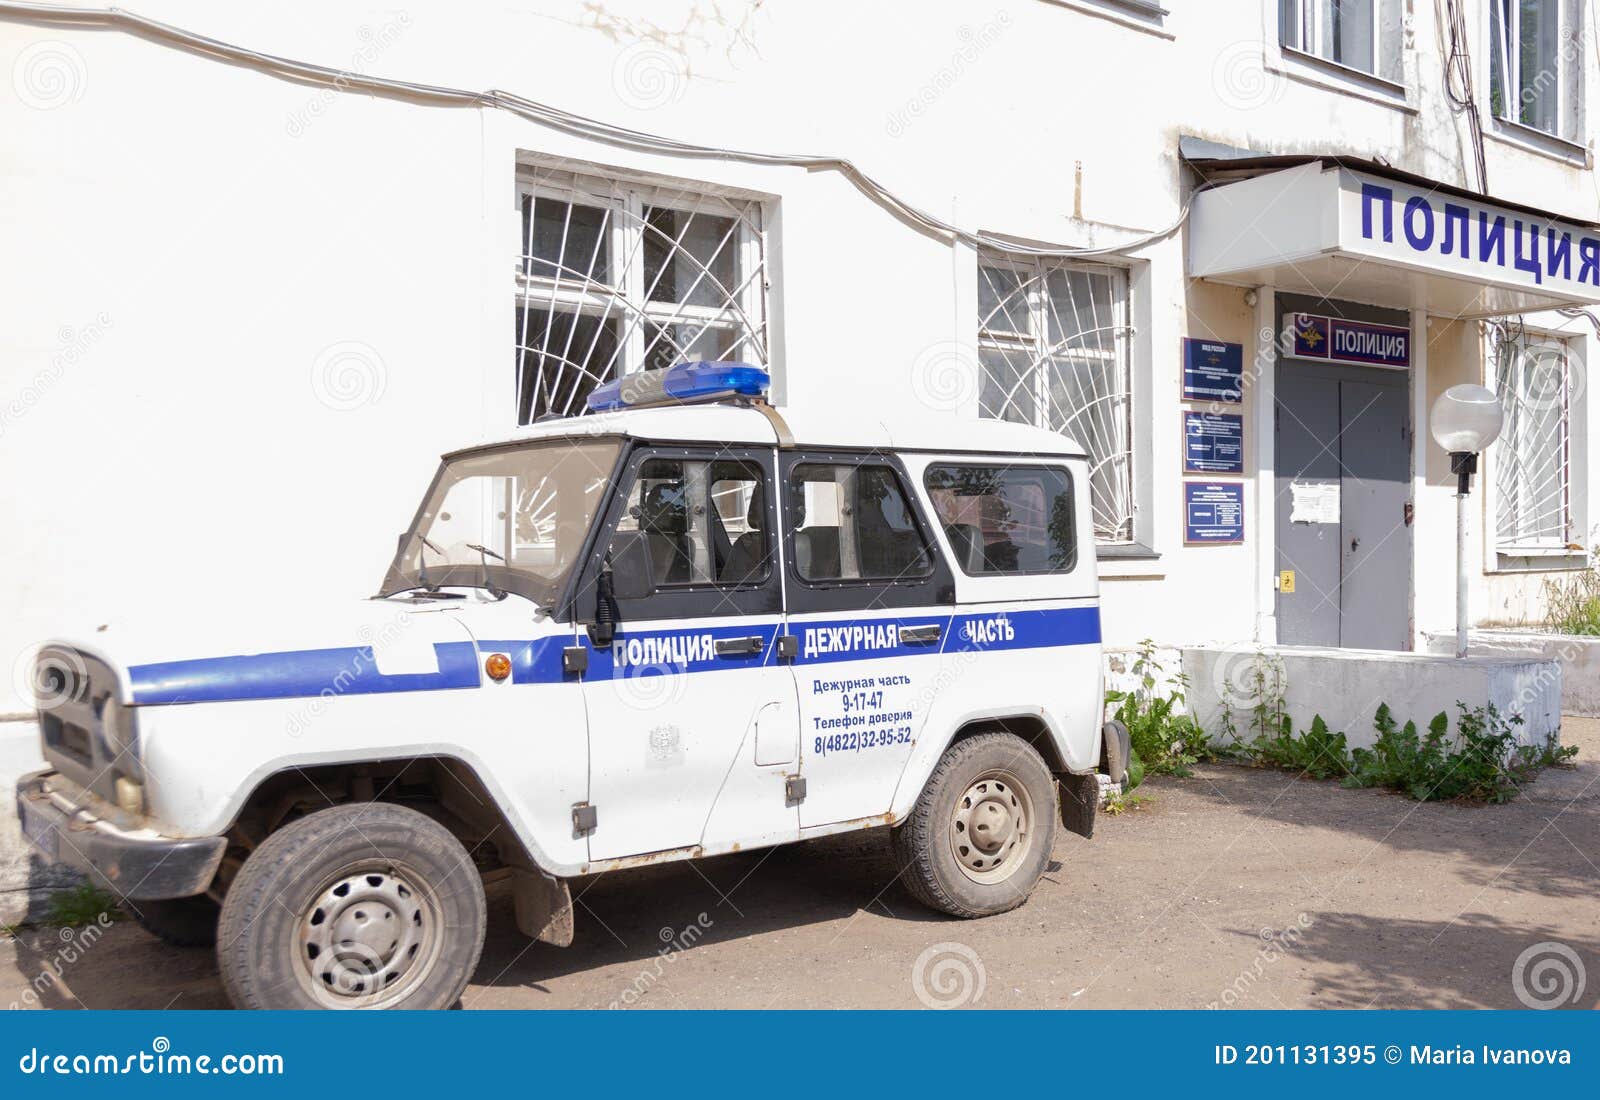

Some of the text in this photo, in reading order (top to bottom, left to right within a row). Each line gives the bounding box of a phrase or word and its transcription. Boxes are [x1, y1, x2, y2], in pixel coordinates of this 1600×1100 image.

[1361, 182, 1600, 287] ПОЛИЦИЯ
[1335, 328, 1406, 360] ПОЛИЦИЯ
[612, 634, 715, 668] ПОЛИЦИЯ
[803, 617, 1016, 659] ДЕЖУРНАЯ ЧАСТЬ
[813, 675, 911, 695] Дежурная часть
[842, 691, 883, 712] 9-17-47
[813, 710, 913, 730] Телефон доверия
[814, 726, 911, 758] 8(4822)32-95-52
